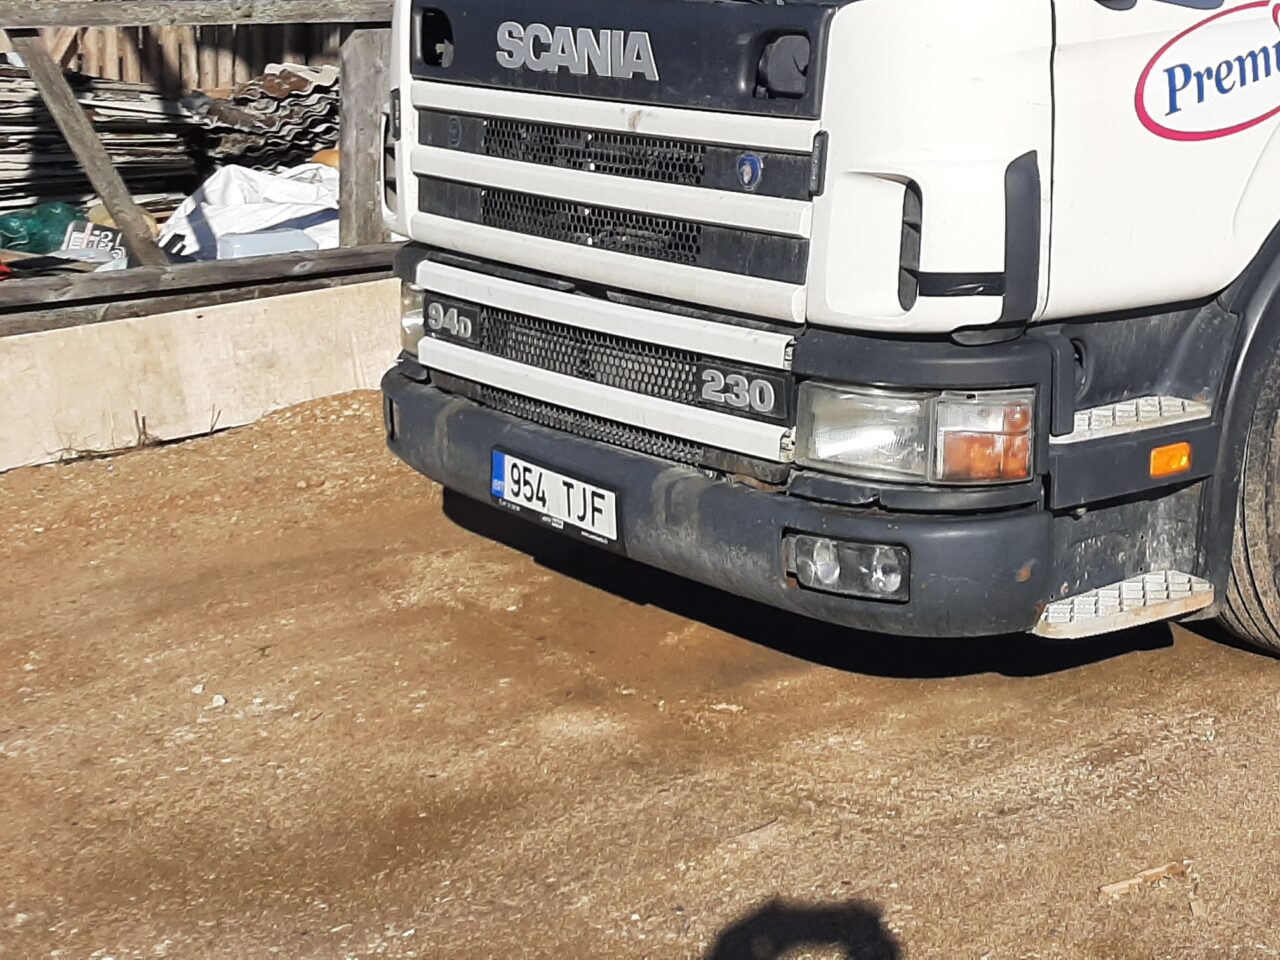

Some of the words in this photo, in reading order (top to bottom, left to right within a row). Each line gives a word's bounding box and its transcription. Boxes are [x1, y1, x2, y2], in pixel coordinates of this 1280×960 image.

[496, 21, 659, 81] SCANIA
[702, 369, 774, 412] 230
[510, 462, 547, 508] 954
[562, 480, 606, 528] TJF
